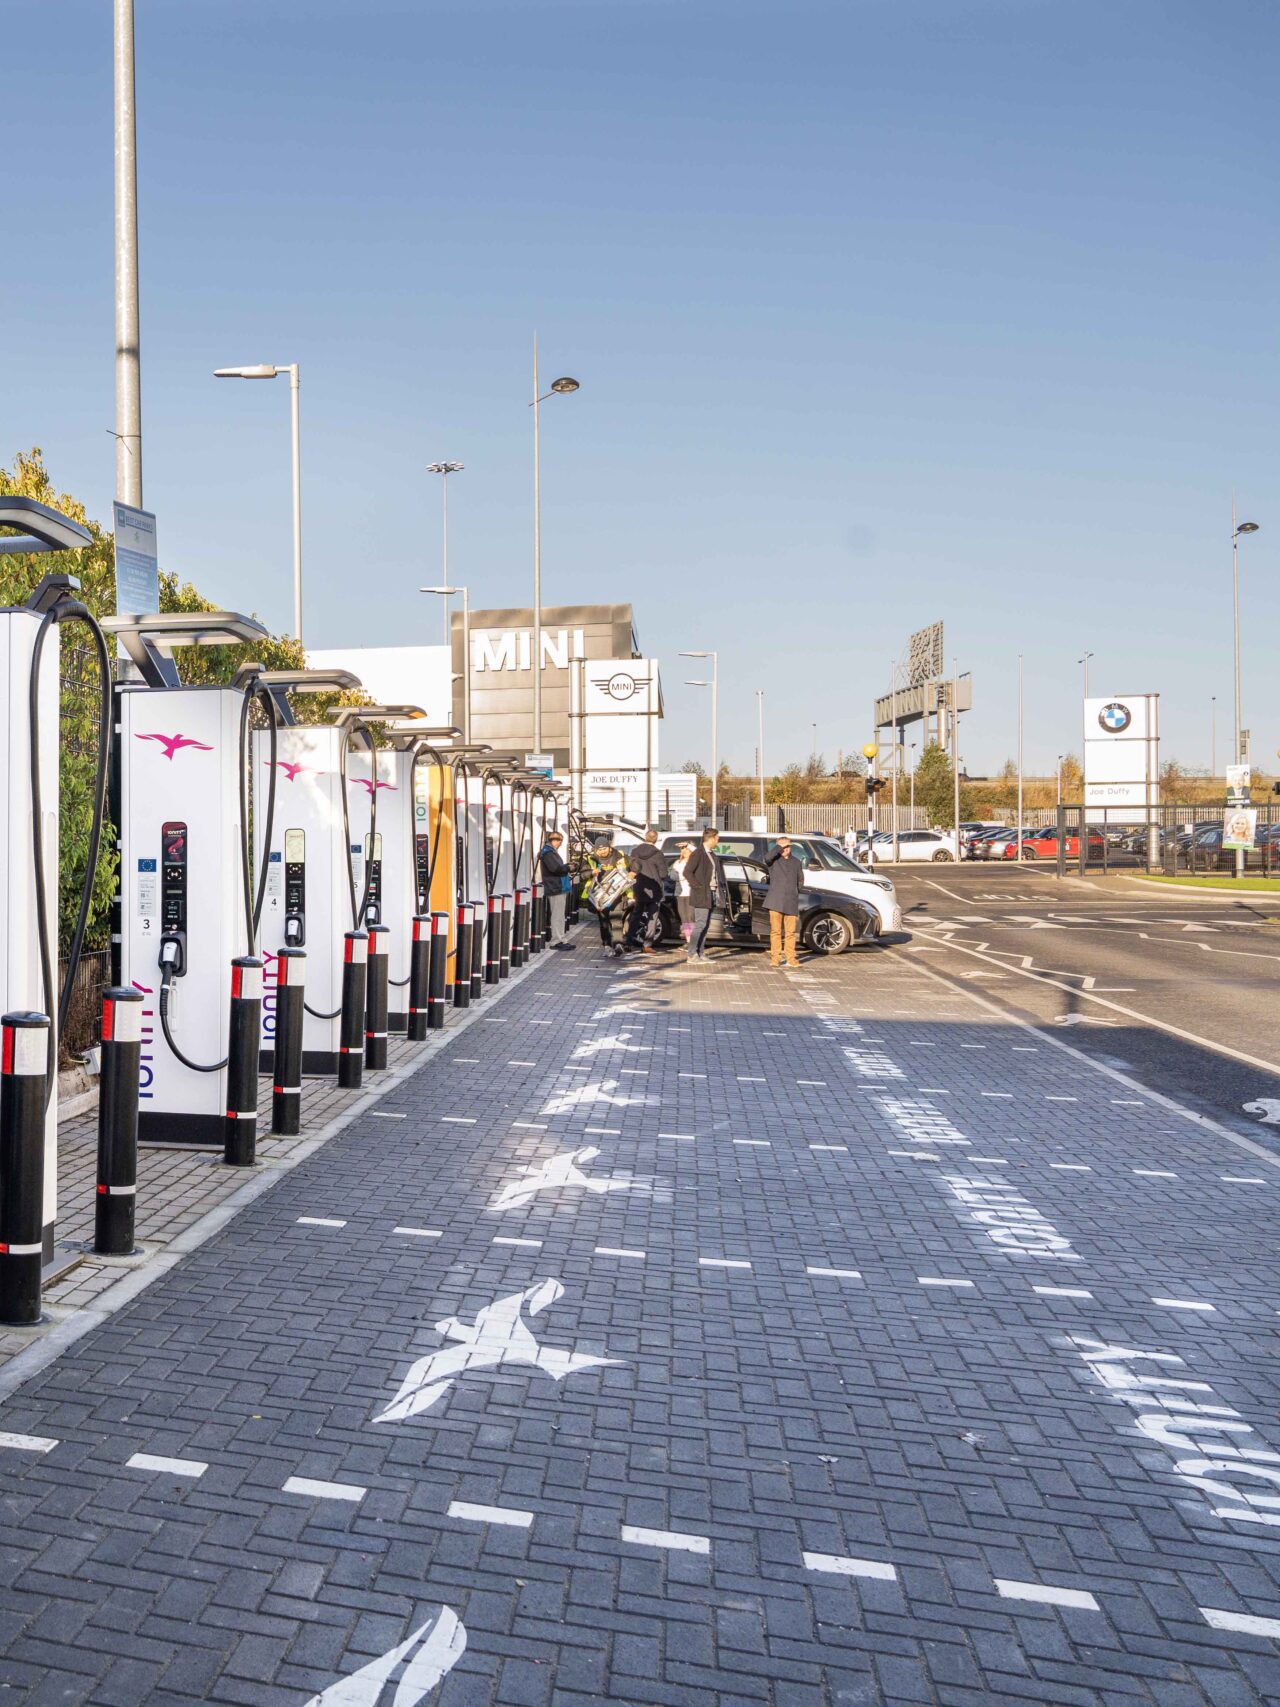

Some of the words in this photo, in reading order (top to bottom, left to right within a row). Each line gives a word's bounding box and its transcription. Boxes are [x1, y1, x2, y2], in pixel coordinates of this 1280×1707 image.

[475, 629, 585, 672] MINI
[611, 683, 632, 691] MINI
[591, 775, 607, 784] JOE
[609, 775, 639, 783] DUFFY
[1089, 788, 1104, 796] Joe
[1107, 787, 1130, 796] Duffy
[271, 898, 277, 906] 4
[143, 919, 150, 930] 3
[263, 950, 278, 1040] IONITY
[939, 1175, 1085, 1261] IONITY
